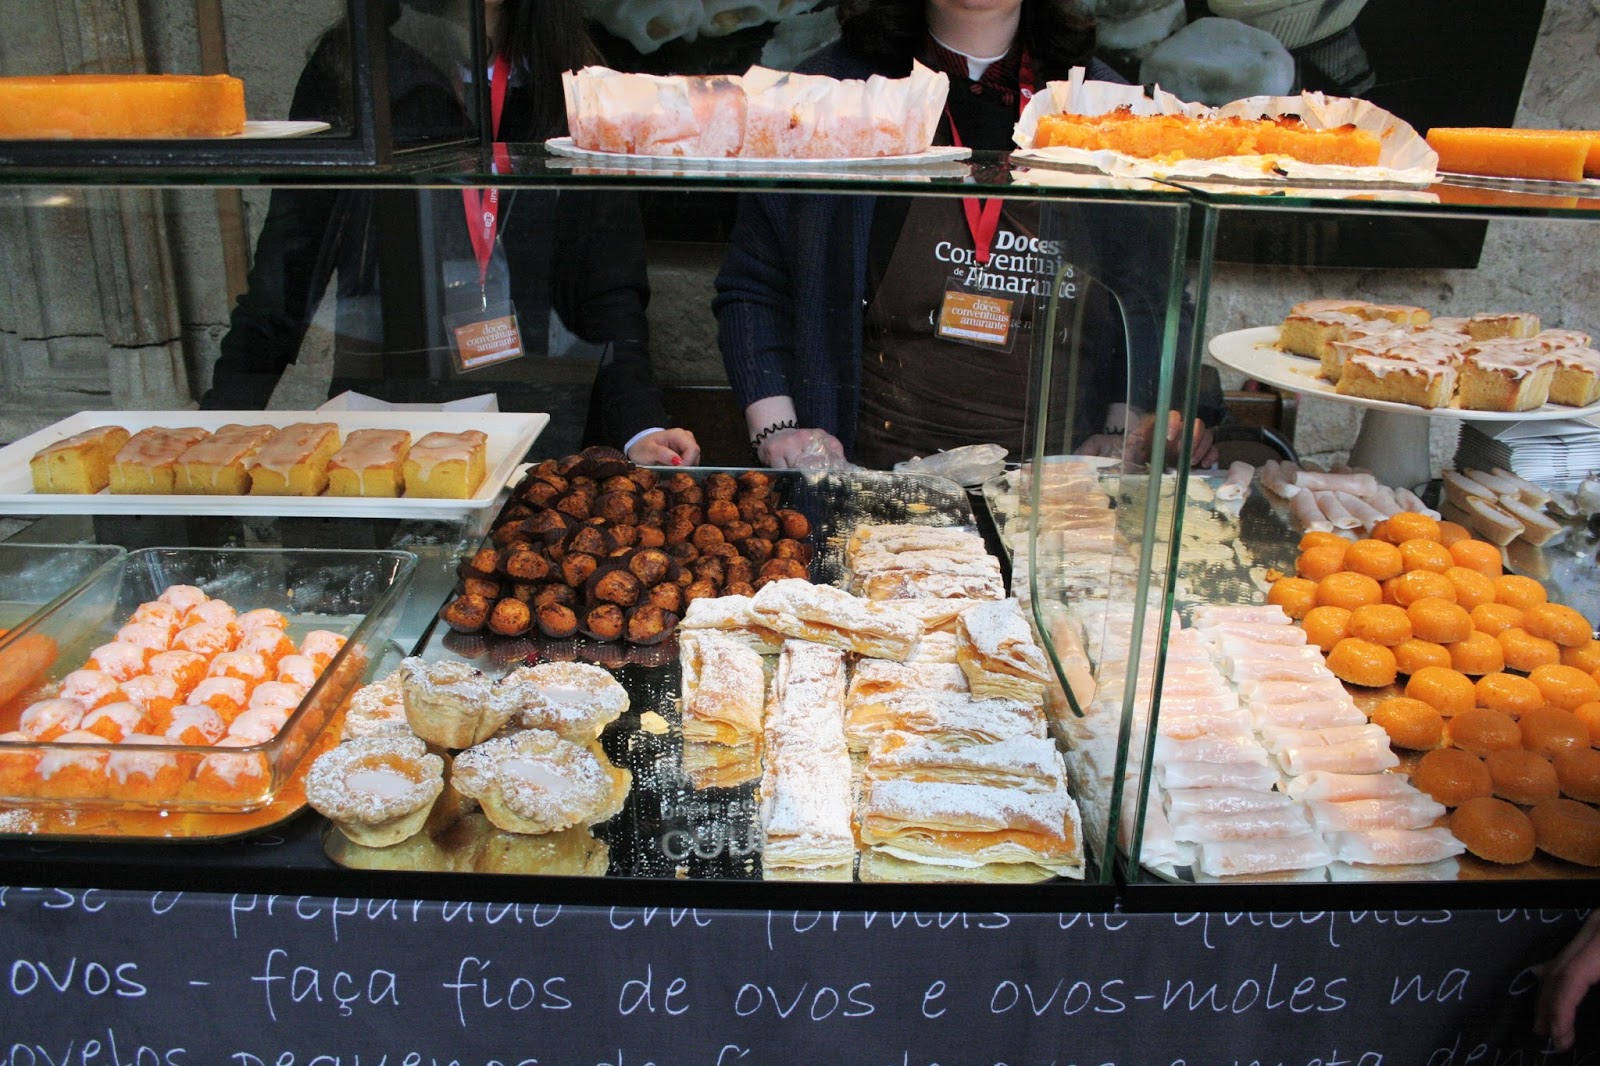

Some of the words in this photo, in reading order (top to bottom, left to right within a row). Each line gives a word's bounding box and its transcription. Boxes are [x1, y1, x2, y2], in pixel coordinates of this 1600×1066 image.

[995, 231, 1060, 256] Doces
[953, 267, 965, 277] de
[972, 299, 1001, 314] doces
[951, 307, 1009, 323] conventuais
[482, 323, 508, 335] doces
[960, 316, 1007, 331] amarante
[466, 327, 517, 347] conventuais
[10, 957, 147, 996] ovos
[251, 948, 399, 1021] faça
[618, 964, 690, 1015] de
[734, 982, 876, 1021] ovos
[922, 980, 946, 1019] e
[990, 963, 1347, 1016] ovos-moles
[1390, 968, 1470, 1005] na
[0, 1028, 186, 1066] ovelos
